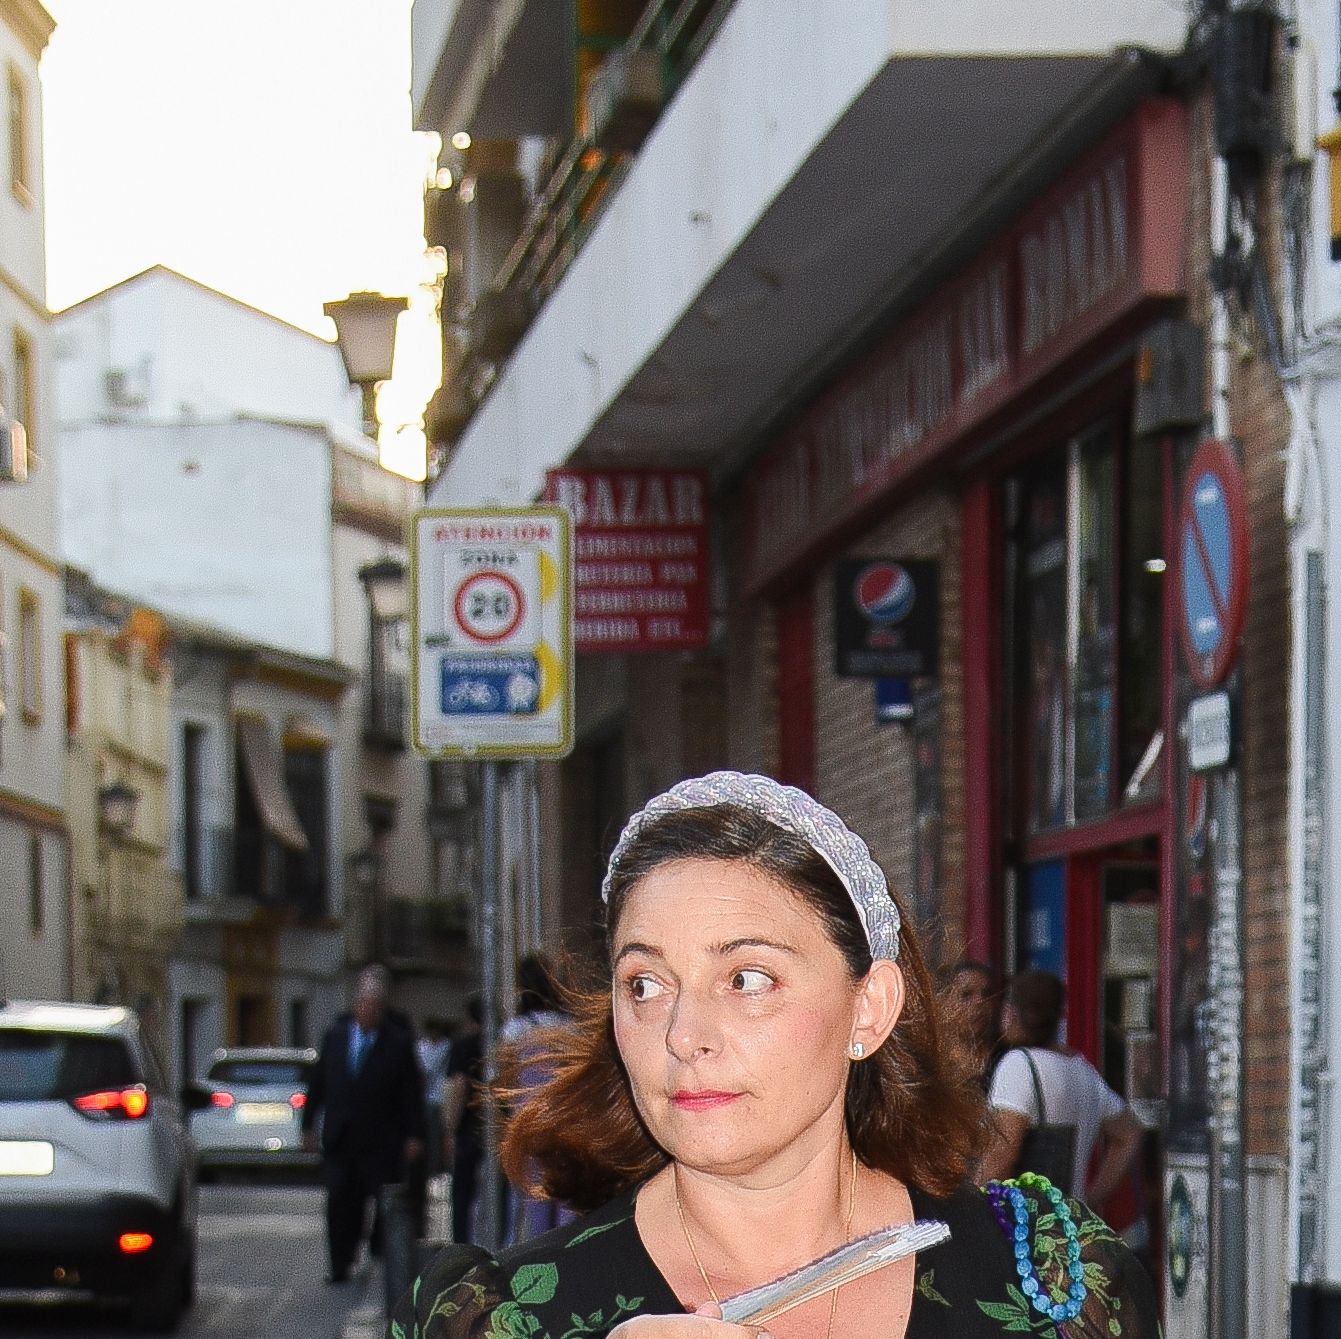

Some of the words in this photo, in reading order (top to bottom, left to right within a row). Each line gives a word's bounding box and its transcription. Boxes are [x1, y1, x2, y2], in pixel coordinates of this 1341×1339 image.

[557, 475, 703, 526] BAZAR
[576, 534, 698, 556] LIMENTACION
[470, 590, 511, 619] 20
